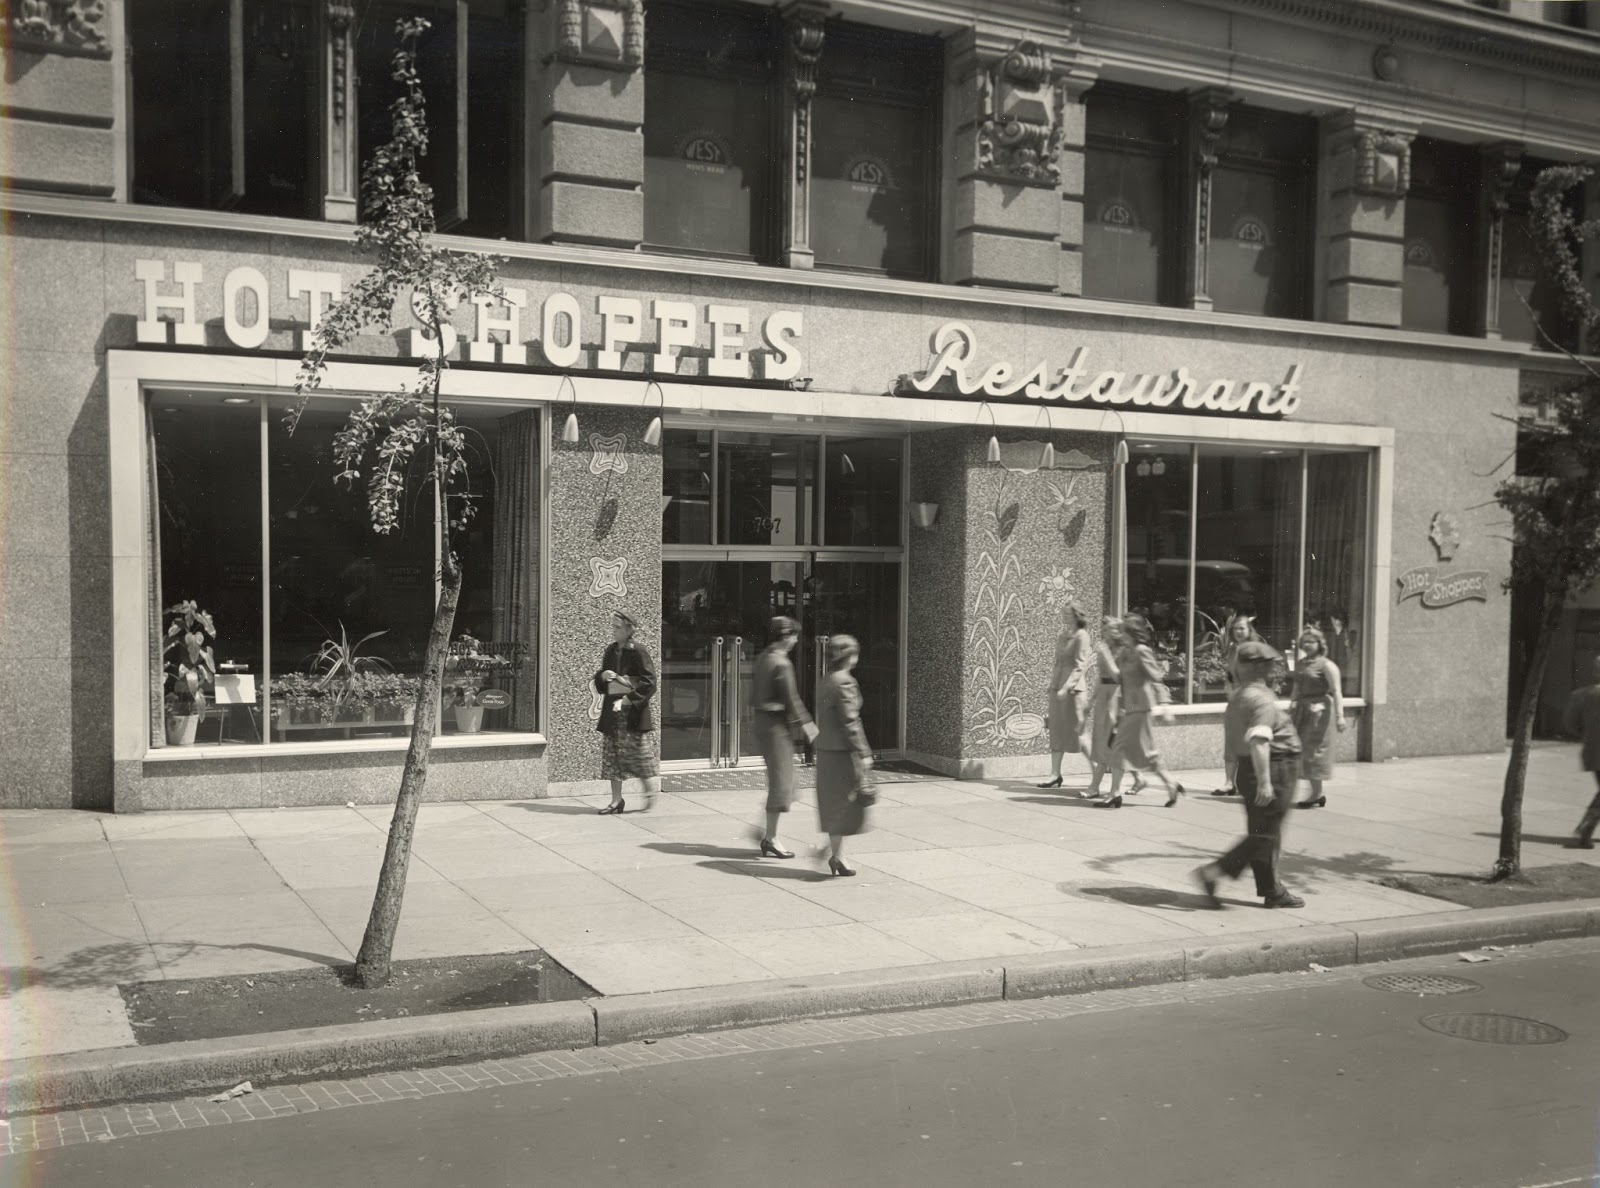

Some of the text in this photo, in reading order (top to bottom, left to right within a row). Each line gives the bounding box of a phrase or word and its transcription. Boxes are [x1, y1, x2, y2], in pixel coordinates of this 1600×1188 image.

[685, 139, 721, 162] WEST
[850, 162, 883, 184] WEST
[136, 259, 803, 381] HOT SHOPPES
[913, 321, 1304, 415] Restaurant
[754, 516, 782, 534] 707
